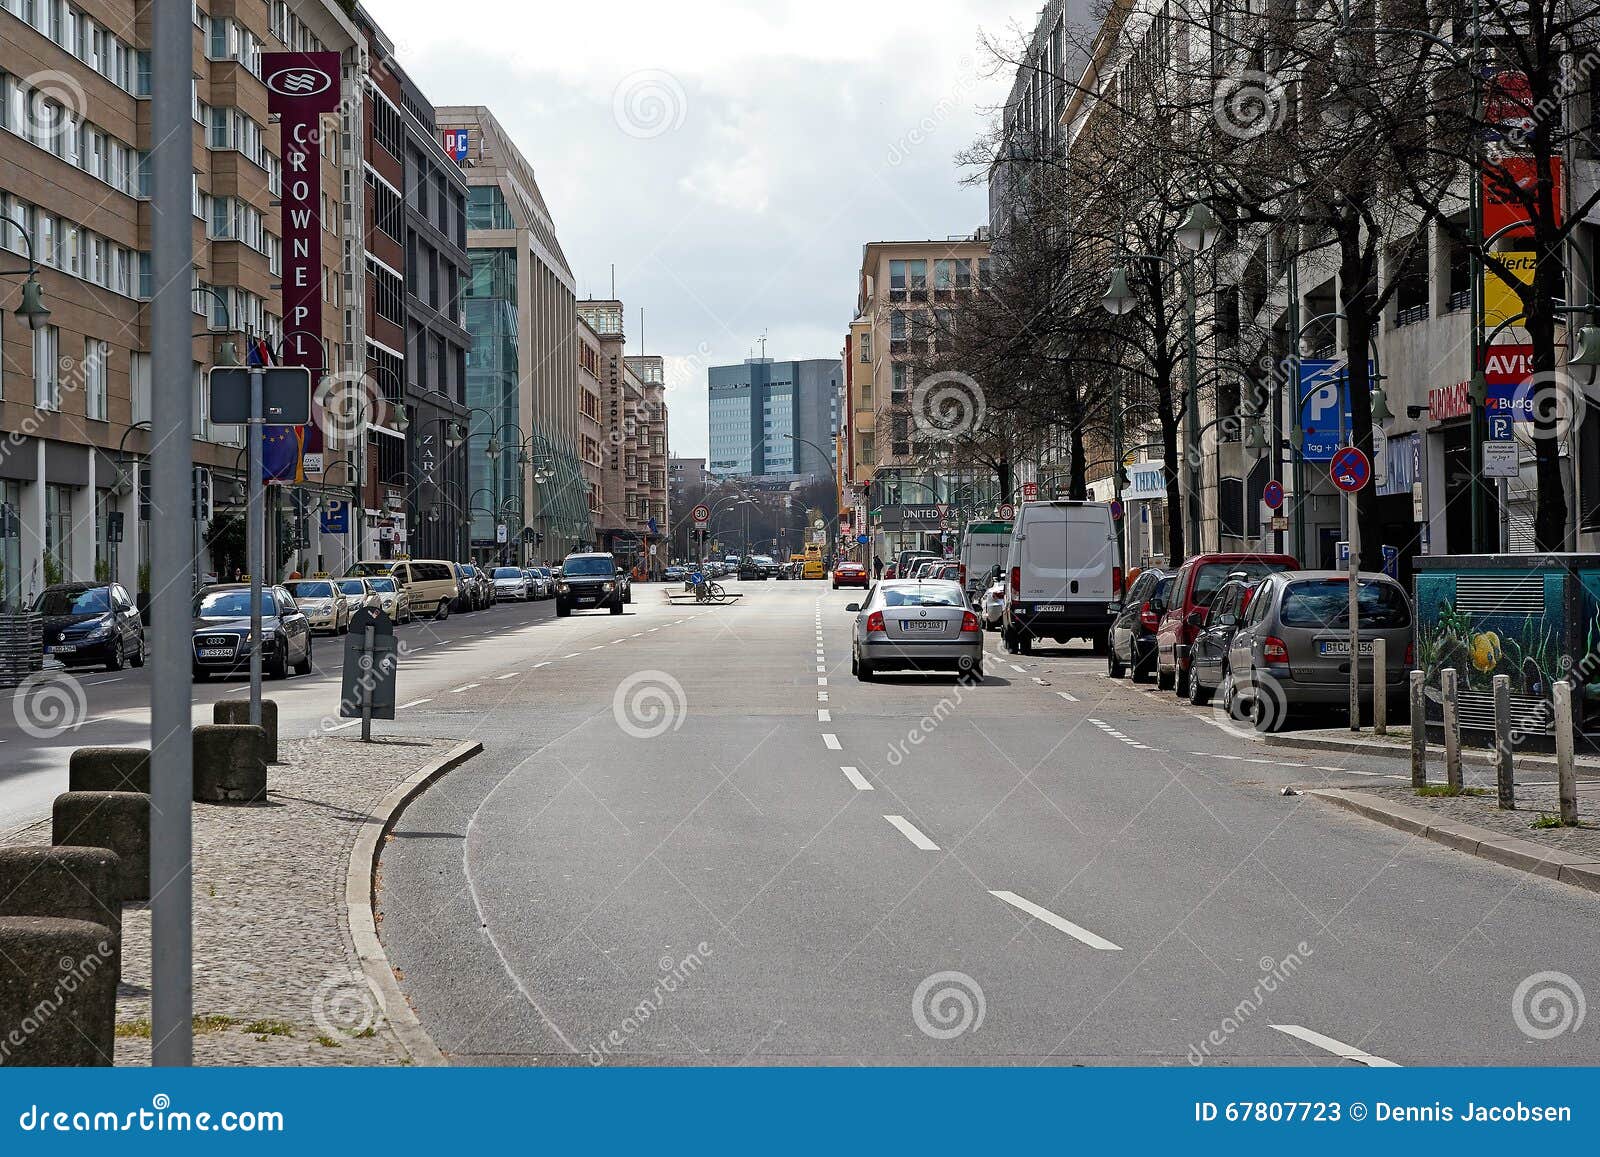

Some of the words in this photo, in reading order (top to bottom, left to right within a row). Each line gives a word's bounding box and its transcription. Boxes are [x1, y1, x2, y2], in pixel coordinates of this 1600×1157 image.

[290, 123, 311, 287] CROWNE
[610, 354, 618, 394] HOTEL
[1310, 380, 1338, 421] P
[1499, 397, 1534, 411] Budg
[1494, 419, 1507, 438] P
[1307, 443, 1323, 453] Tag
[422, 435, 434, 484] ZARA
[1135, 470, 1167, 493] THERM
[696, 509, 705, 518] 30
[903, 510, 938, 519] UNITED
[1002, 508, 1011, 517] 30
